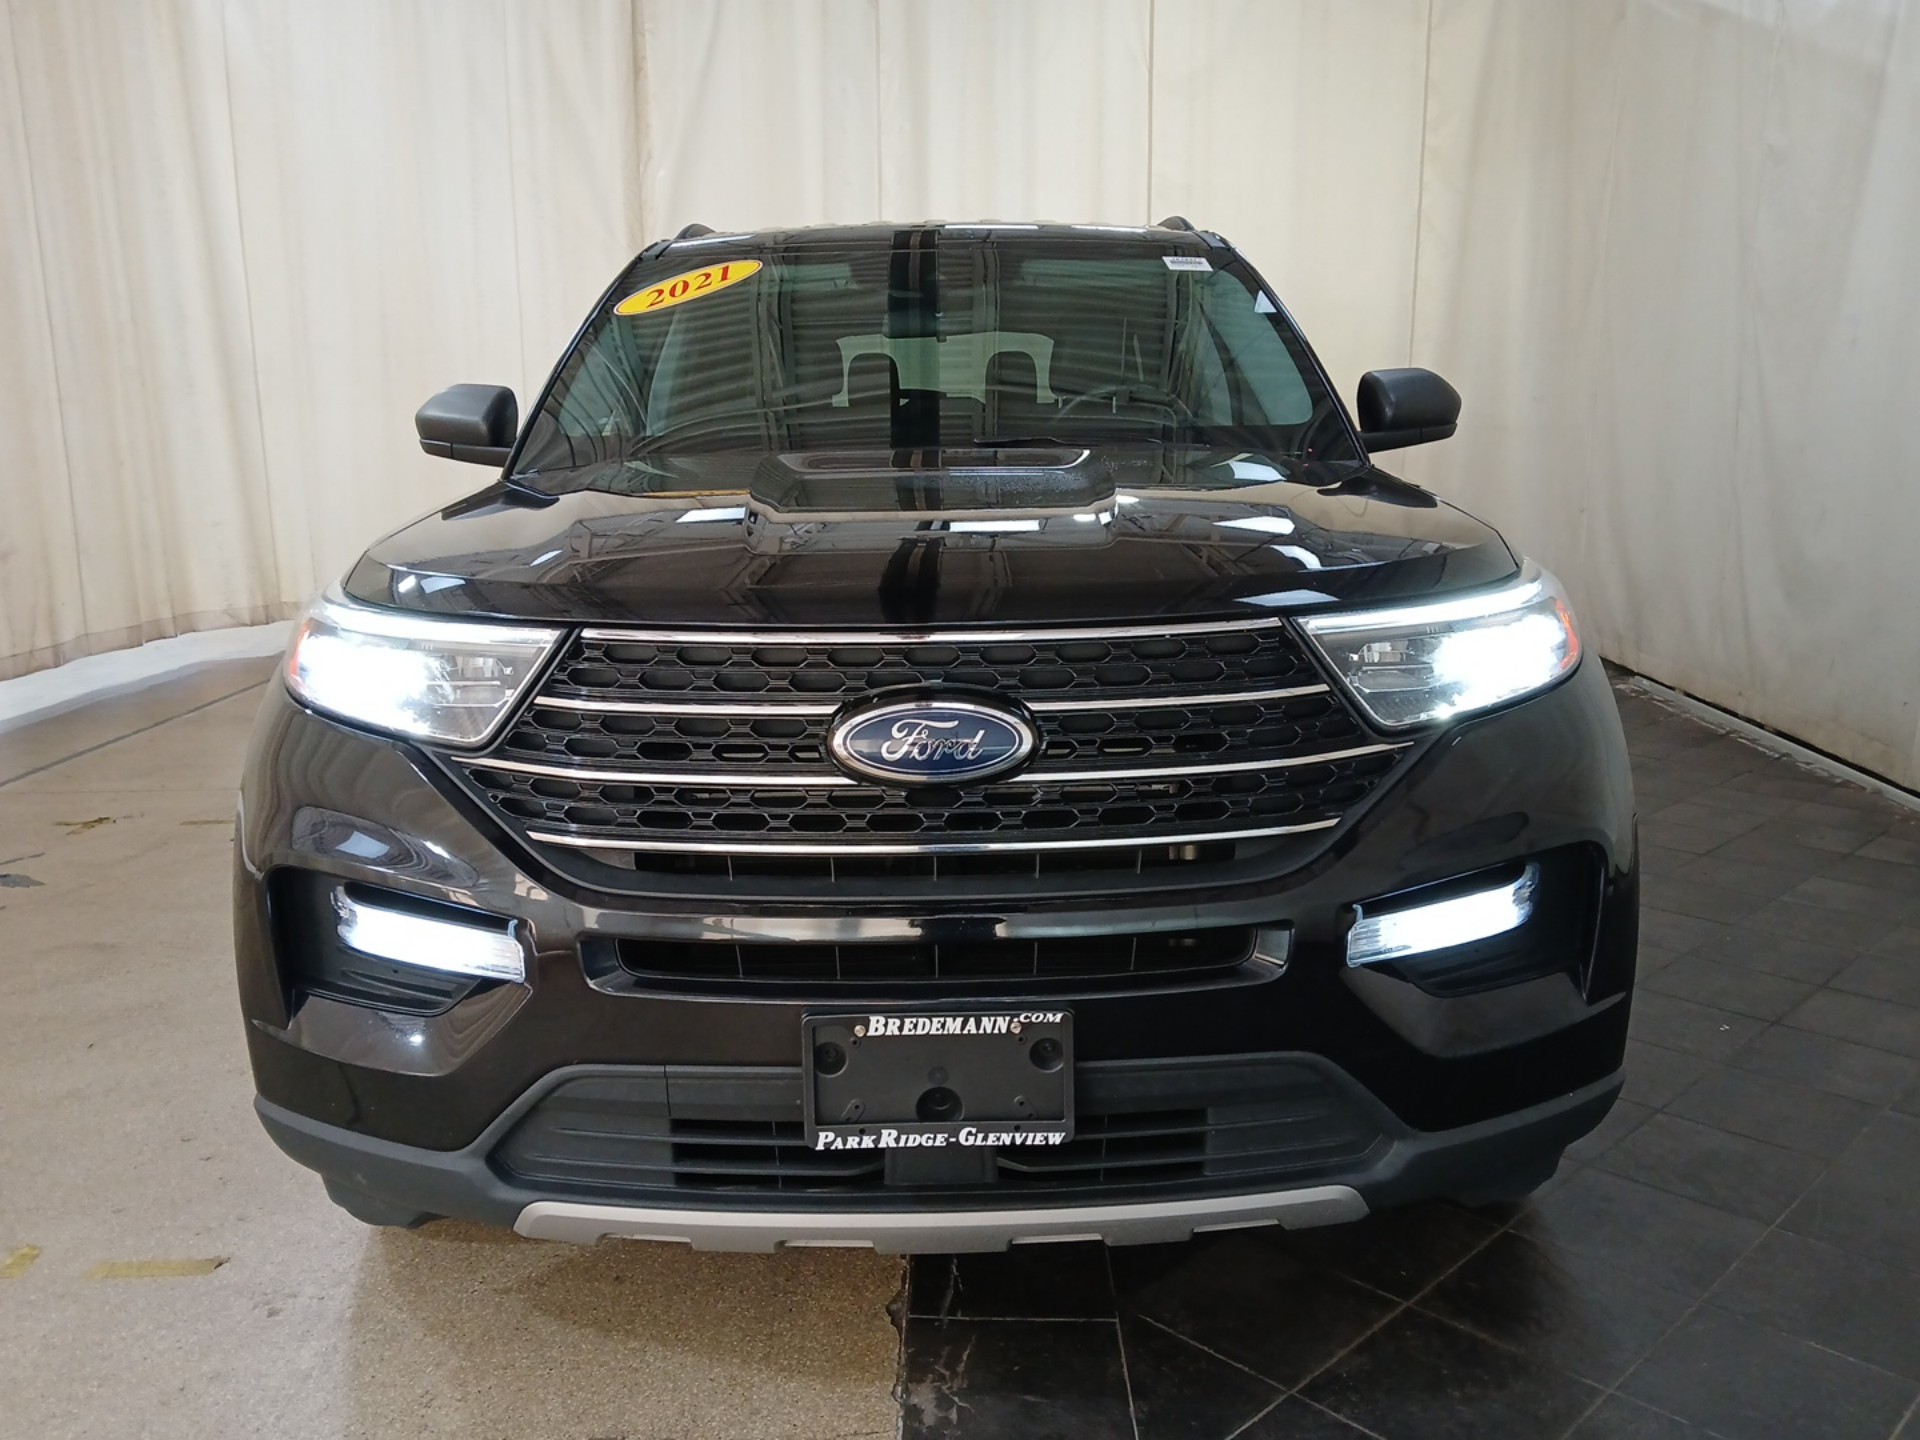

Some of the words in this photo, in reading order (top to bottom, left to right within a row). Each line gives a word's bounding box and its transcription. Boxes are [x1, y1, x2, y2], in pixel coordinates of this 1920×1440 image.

[646, 265, 730, 308] 2021
[881, 719, 985, 761] Ford
[815, 1130, 877, 1151] PARK
